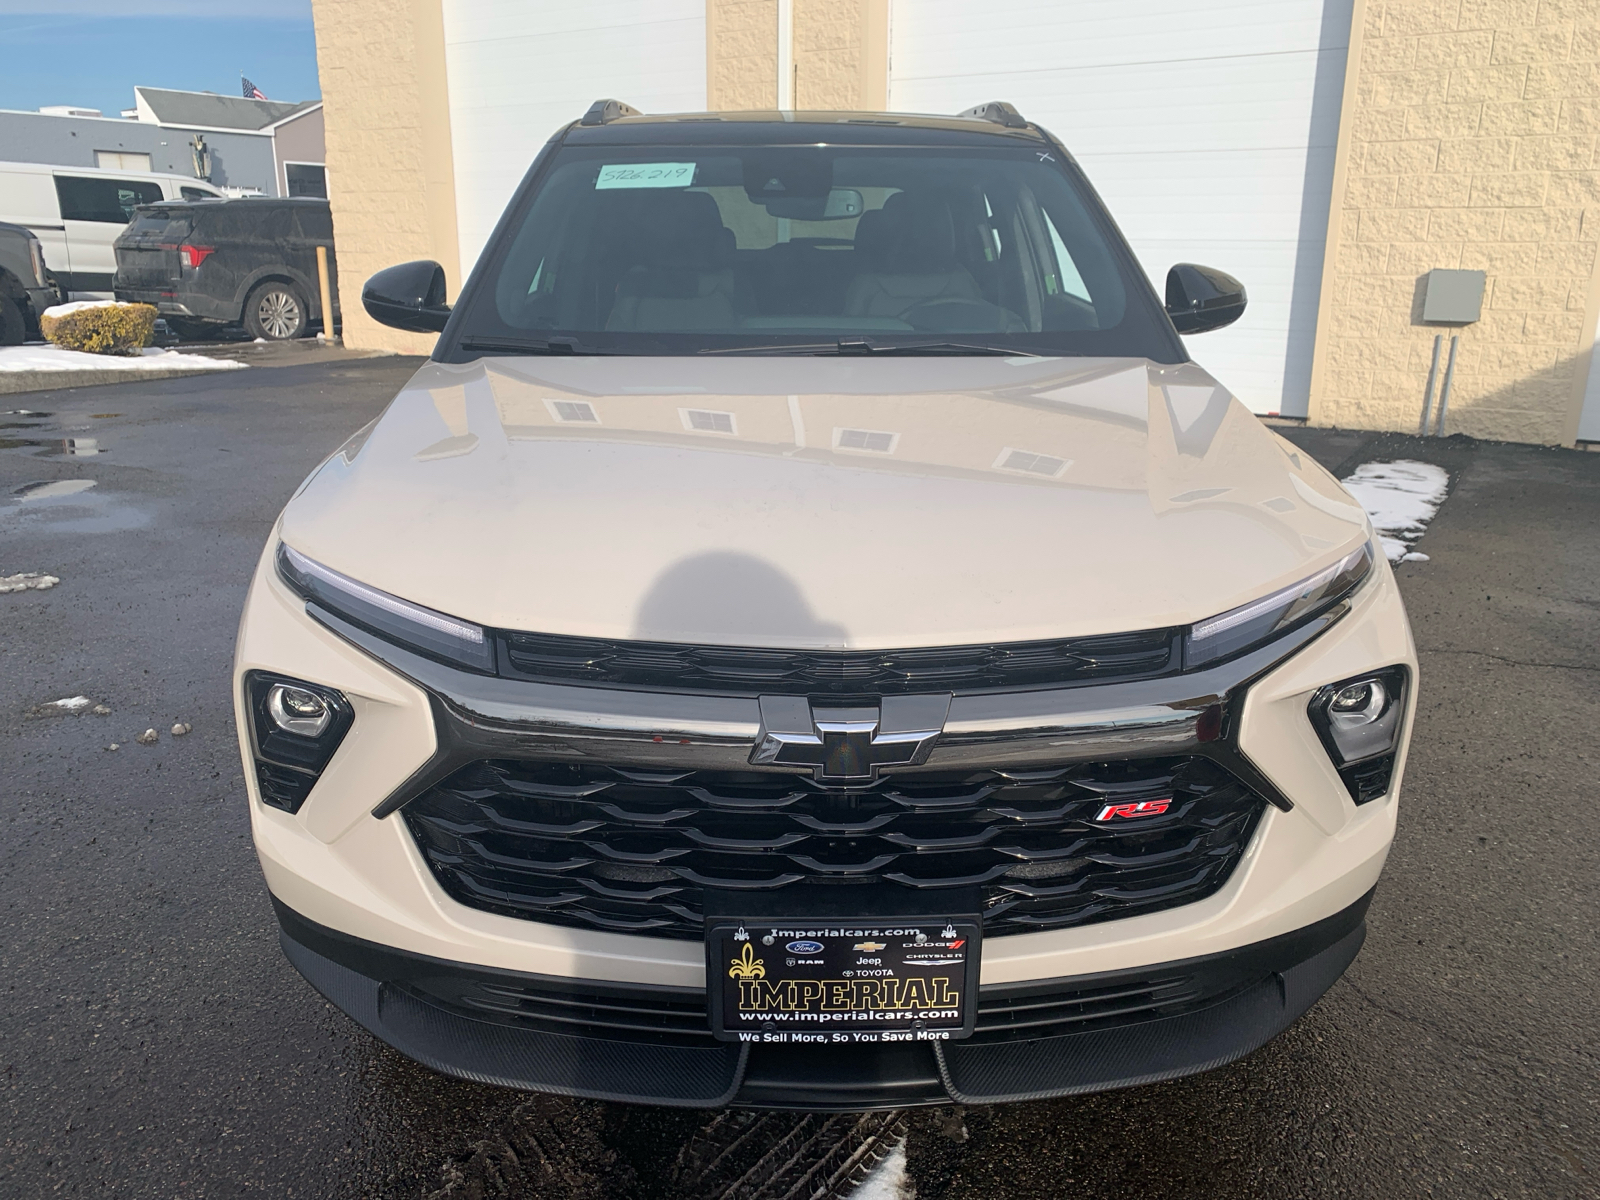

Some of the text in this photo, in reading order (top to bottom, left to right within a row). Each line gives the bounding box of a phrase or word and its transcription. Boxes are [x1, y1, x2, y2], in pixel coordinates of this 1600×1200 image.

[1094, 798, 1172, 821] RS
[771, 928, 920, 939] Imperialcars.com
[856, 957, 882, 966] Jeep
[856, 969, 894, 977] TOYOTA
[739, 978, 959, 1011] IMPERIAL
[739, 1010, 959, 1023] www.imperialcars.com
[739, 1031, 950, 1044] We Sell More, So You Save More
